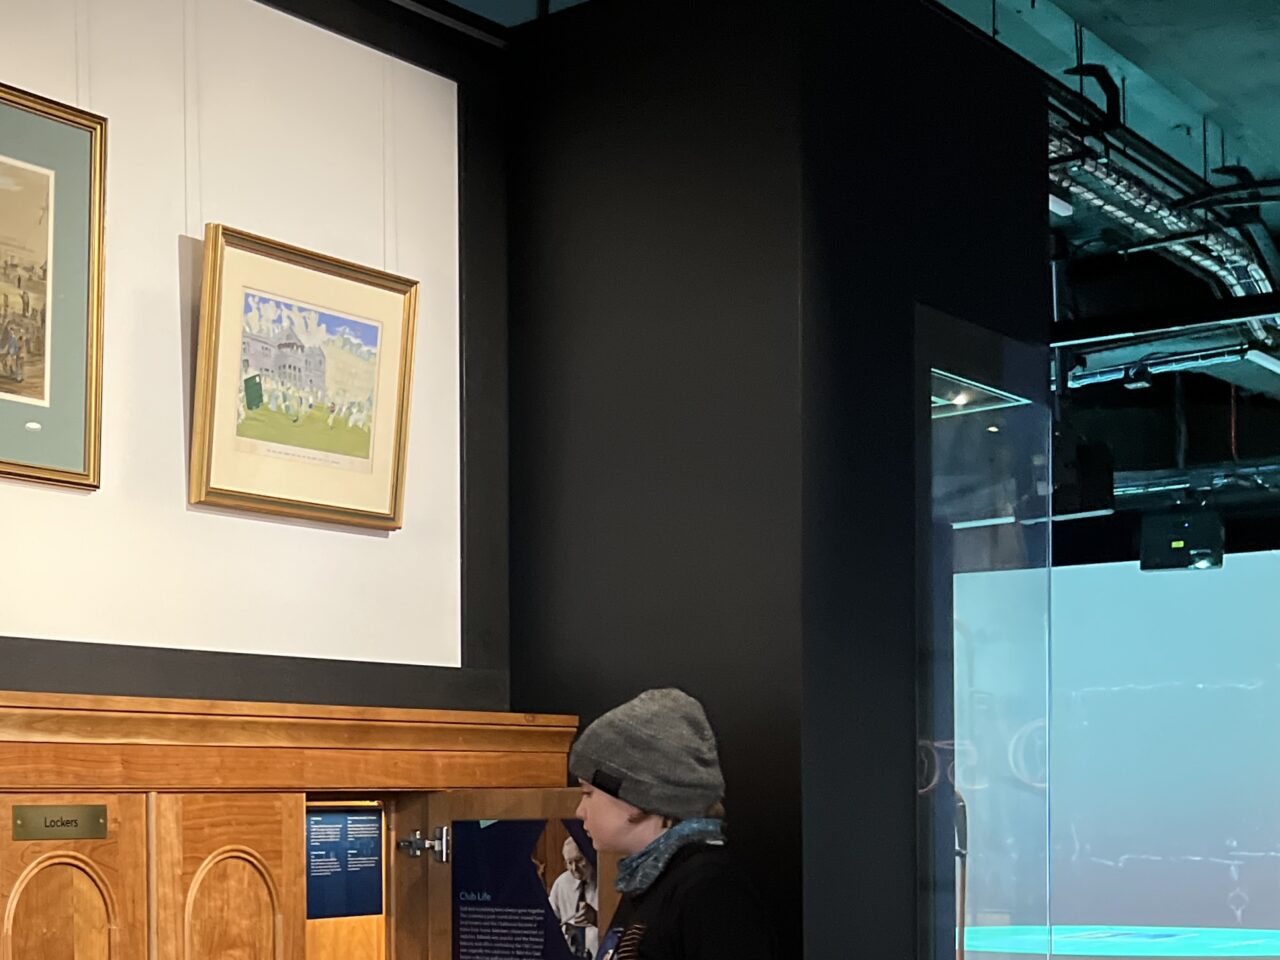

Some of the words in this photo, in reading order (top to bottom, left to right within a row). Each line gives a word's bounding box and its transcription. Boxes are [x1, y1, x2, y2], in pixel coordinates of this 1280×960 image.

[43, 815, 79, 828] Lockers
[459, 891, 477, 901] Club
[477, 891, 492, 901] Life
